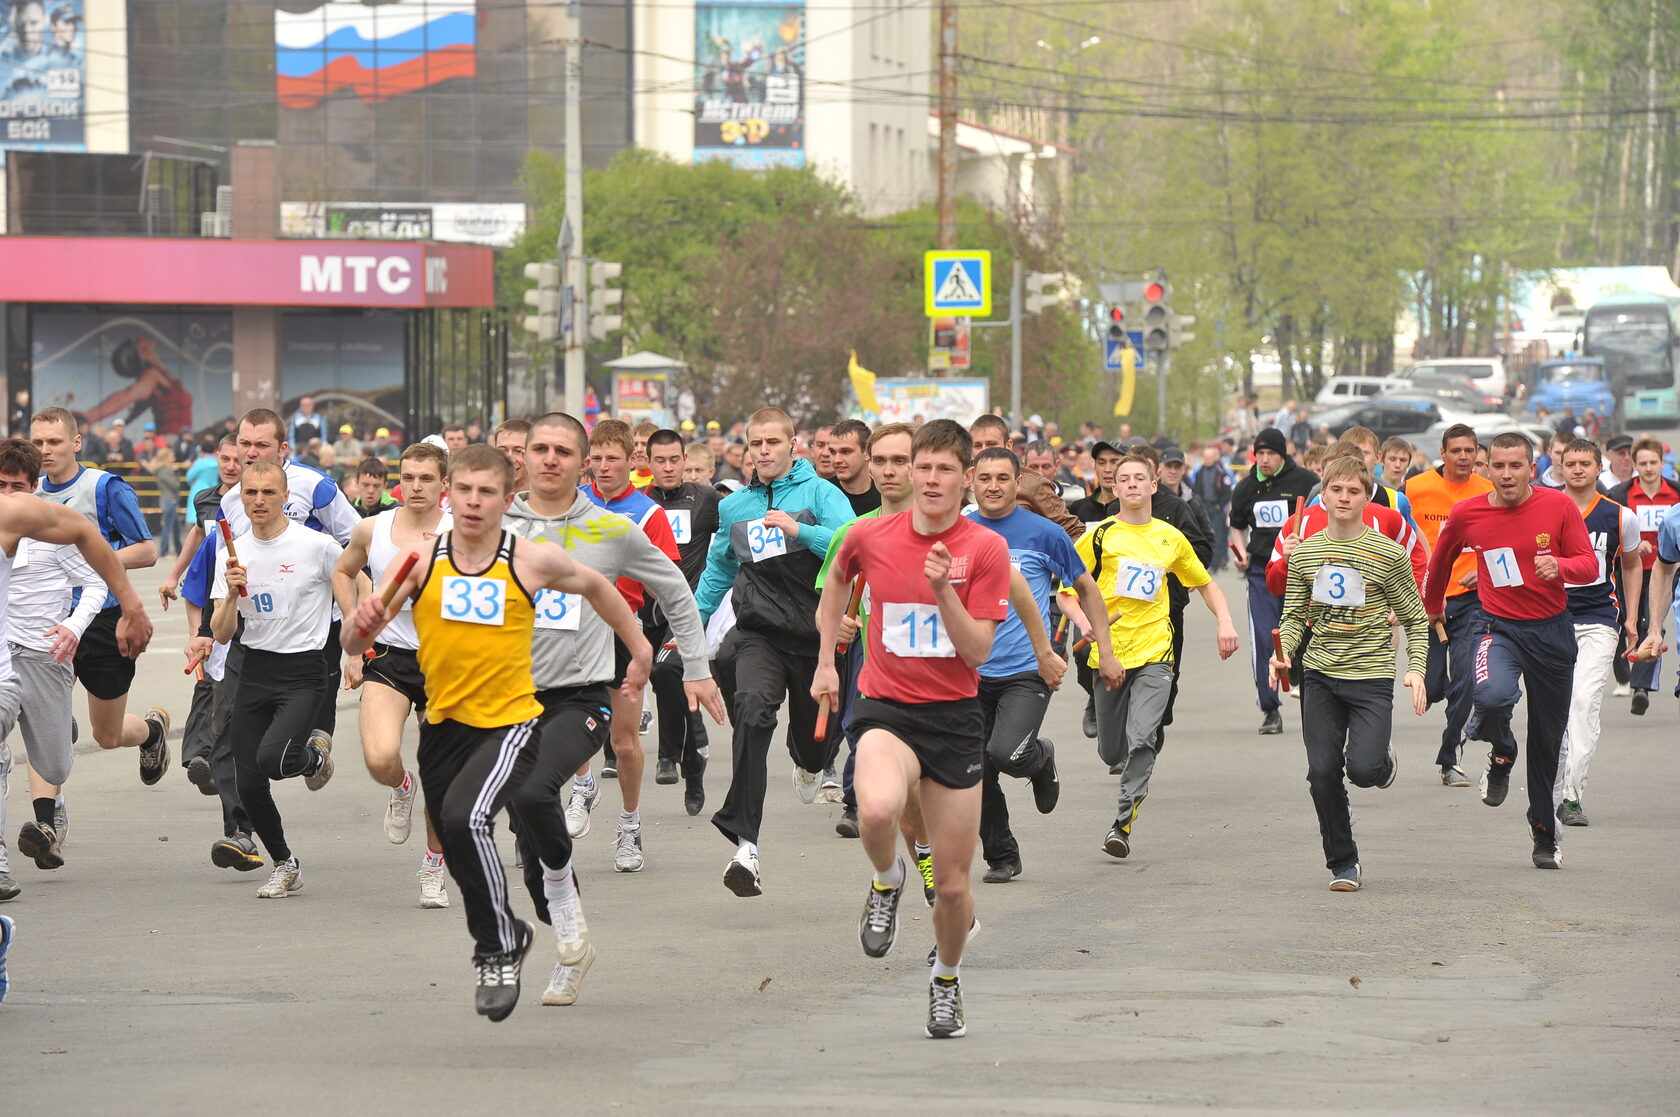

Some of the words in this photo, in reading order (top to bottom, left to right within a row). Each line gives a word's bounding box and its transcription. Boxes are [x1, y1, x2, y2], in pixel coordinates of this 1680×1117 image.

[301, 256, 411, 294] МТС
[1260, 505, 1282, 523] 60
[1643, 509, 1665, 528] 15
[749, 524, 783, 554] 34
[1126, 565, 1156, 595] 73
[1496, 553, 1510, 579] 1
[447, 578, 499, 620] 33
[1328, 572, 1346, 599] 3
[250, 592, 274, 613] 19
[901, 611, 937, 648] 11
